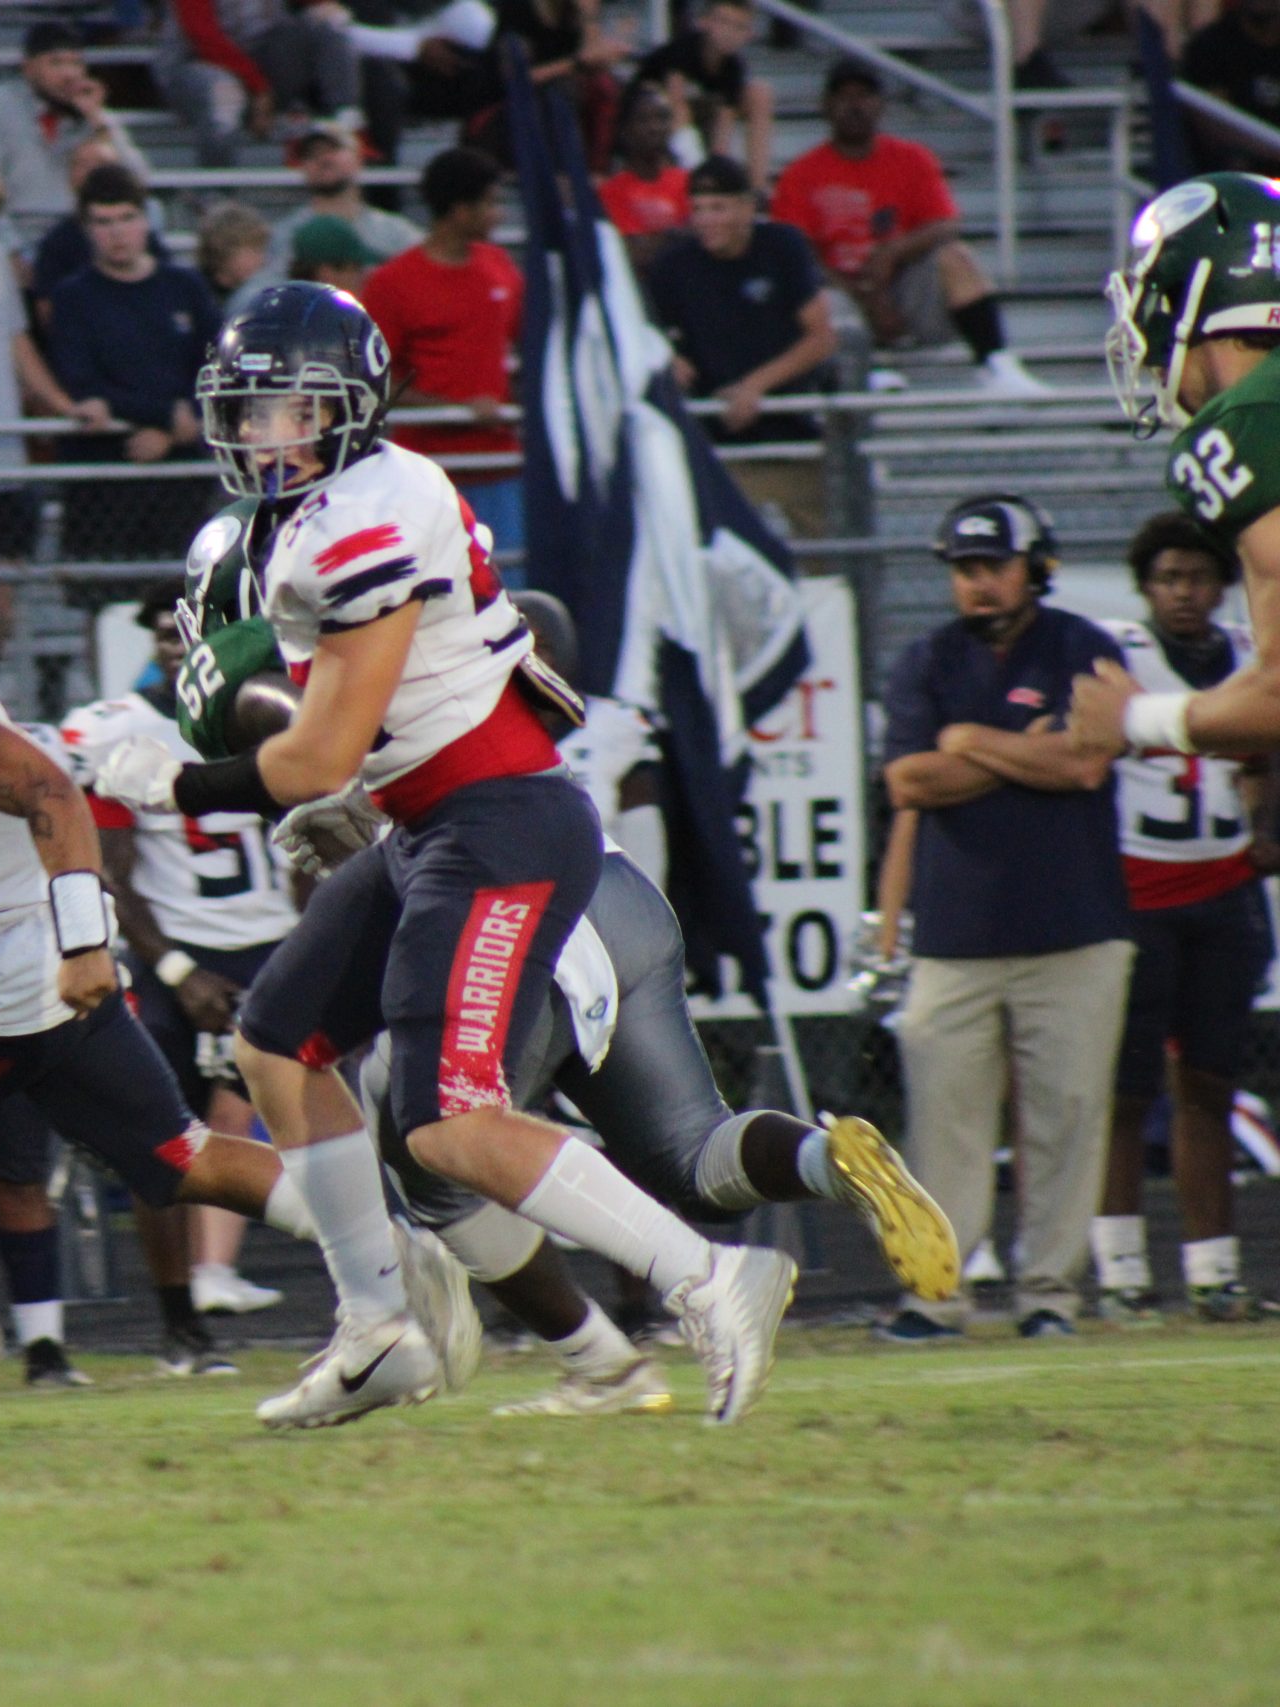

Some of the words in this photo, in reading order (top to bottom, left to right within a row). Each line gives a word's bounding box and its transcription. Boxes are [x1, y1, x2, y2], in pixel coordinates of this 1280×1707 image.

[1173, 428, 1254, 521] 32
[176, 643, 226, 721] 52
[456, 900, 530, 1054] WARRIORS
